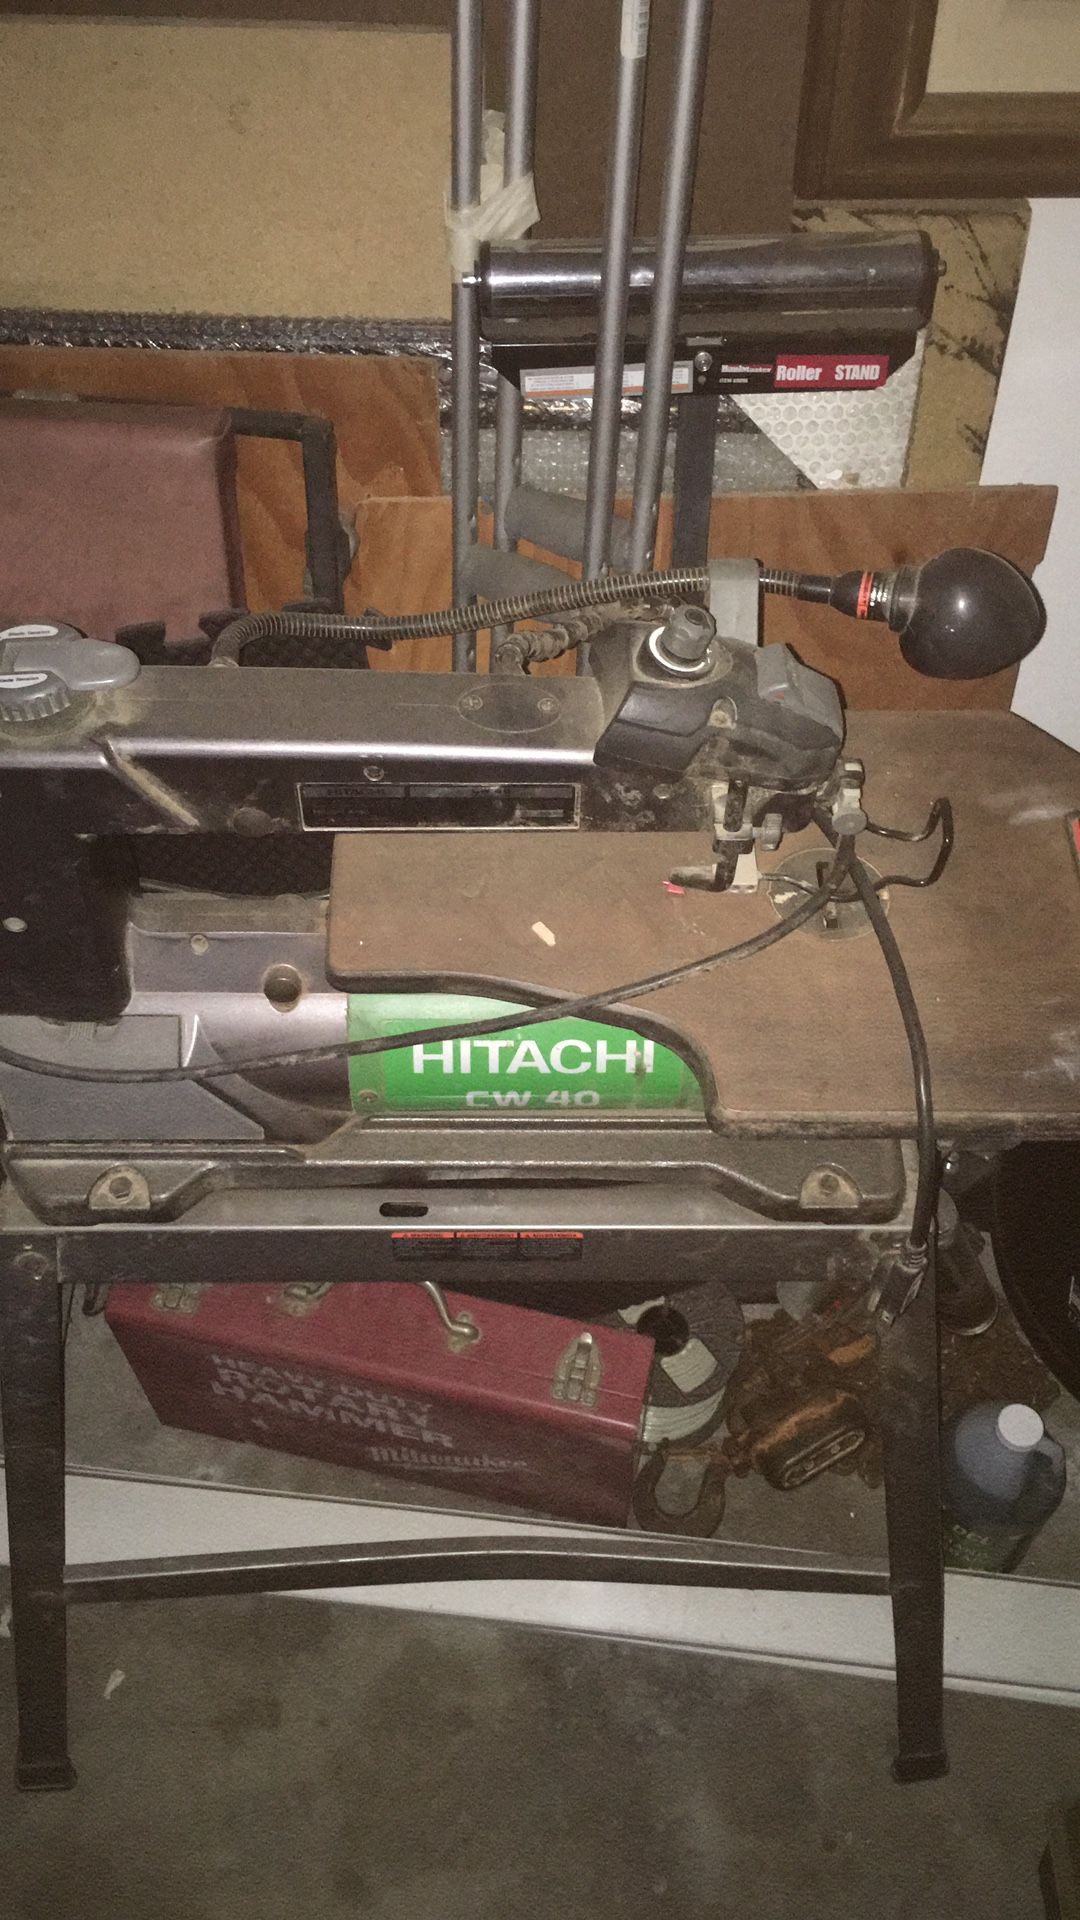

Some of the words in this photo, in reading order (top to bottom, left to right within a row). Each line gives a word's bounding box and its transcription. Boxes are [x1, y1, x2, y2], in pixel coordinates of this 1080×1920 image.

[776, 365, 822, 381] Roller
[835, 364, 880, 380] STAND
[412, 1039, 655, 1074] HITACHI
[465, 1090, 532, 1107] CW
[545, 1090, 600, 1107] 40
[211, 1354, 324, 1389] HEAVY
[340, 1379, 433, 1413] DUTY
[216, 1367, 429, 1429] ROTARY
[210, 1380, 454, 1449] HAMMER
